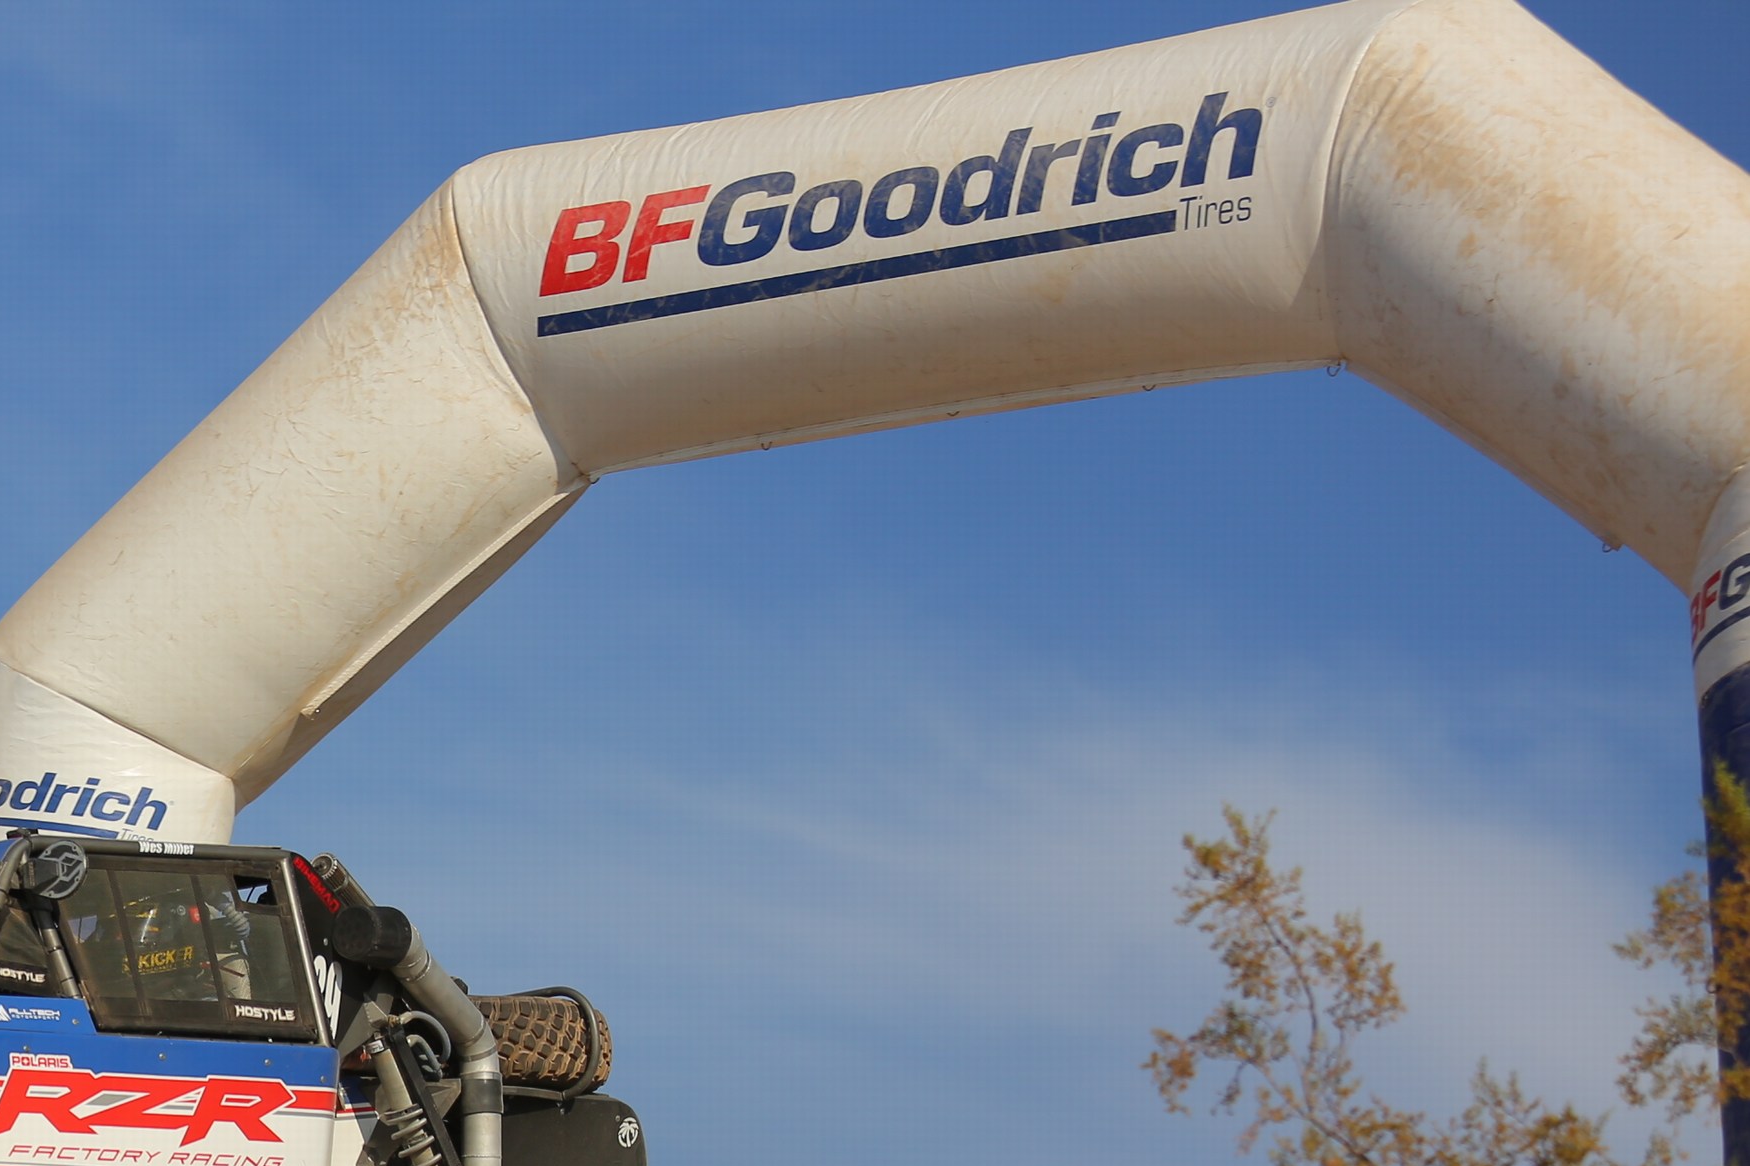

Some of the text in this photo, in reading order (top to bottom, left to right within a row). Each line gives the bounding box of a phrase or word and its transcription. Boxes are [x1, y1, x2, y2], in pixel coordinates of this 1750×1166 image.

[538, 91, 1263, 298] BFGoodrich
[1179, 194, 1253, 233] Tires
[138, 945, 194, 969] KICKR
[235, 1005, 296, 1022] HOSTYLE
[12, 1055, 71, 1069] POLARIS
[8, 1144, 161, 1165] FACTORY
